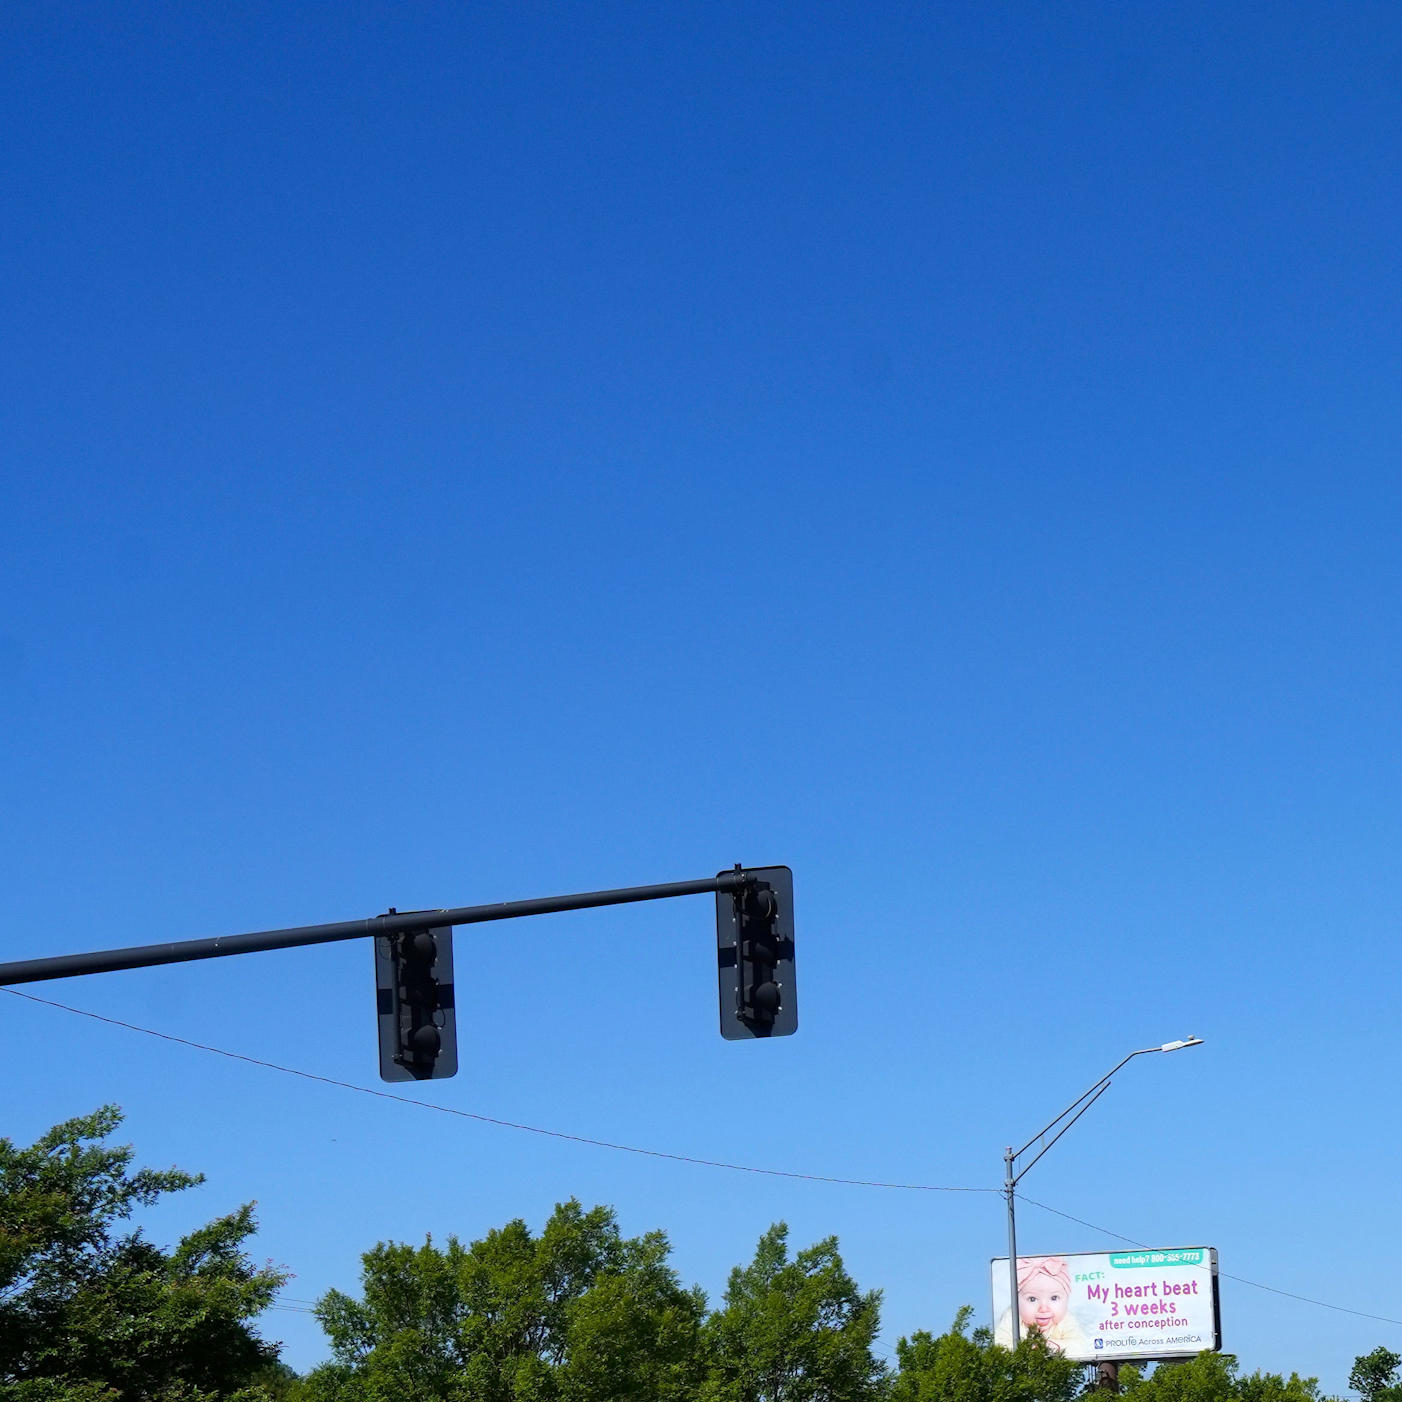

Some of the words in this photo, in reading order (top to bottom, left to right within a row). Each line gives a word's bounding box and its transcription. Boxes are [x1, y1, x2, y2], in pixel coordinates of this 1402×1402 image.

[1075, 1271, 1105, 1282] FACT:
[1087, 1284, 1109, 1303] My
[1115, 1282, 1158, 1299] heart
[1163, 1280, 1198, 1296] beat
[1111, 1301, 1118, 1316] 3
[1124, 1299, 1176, 1316] weeks
[1099, 1318, 1124, 1331] after
[1128, 1316, 1188, 1331] conception
